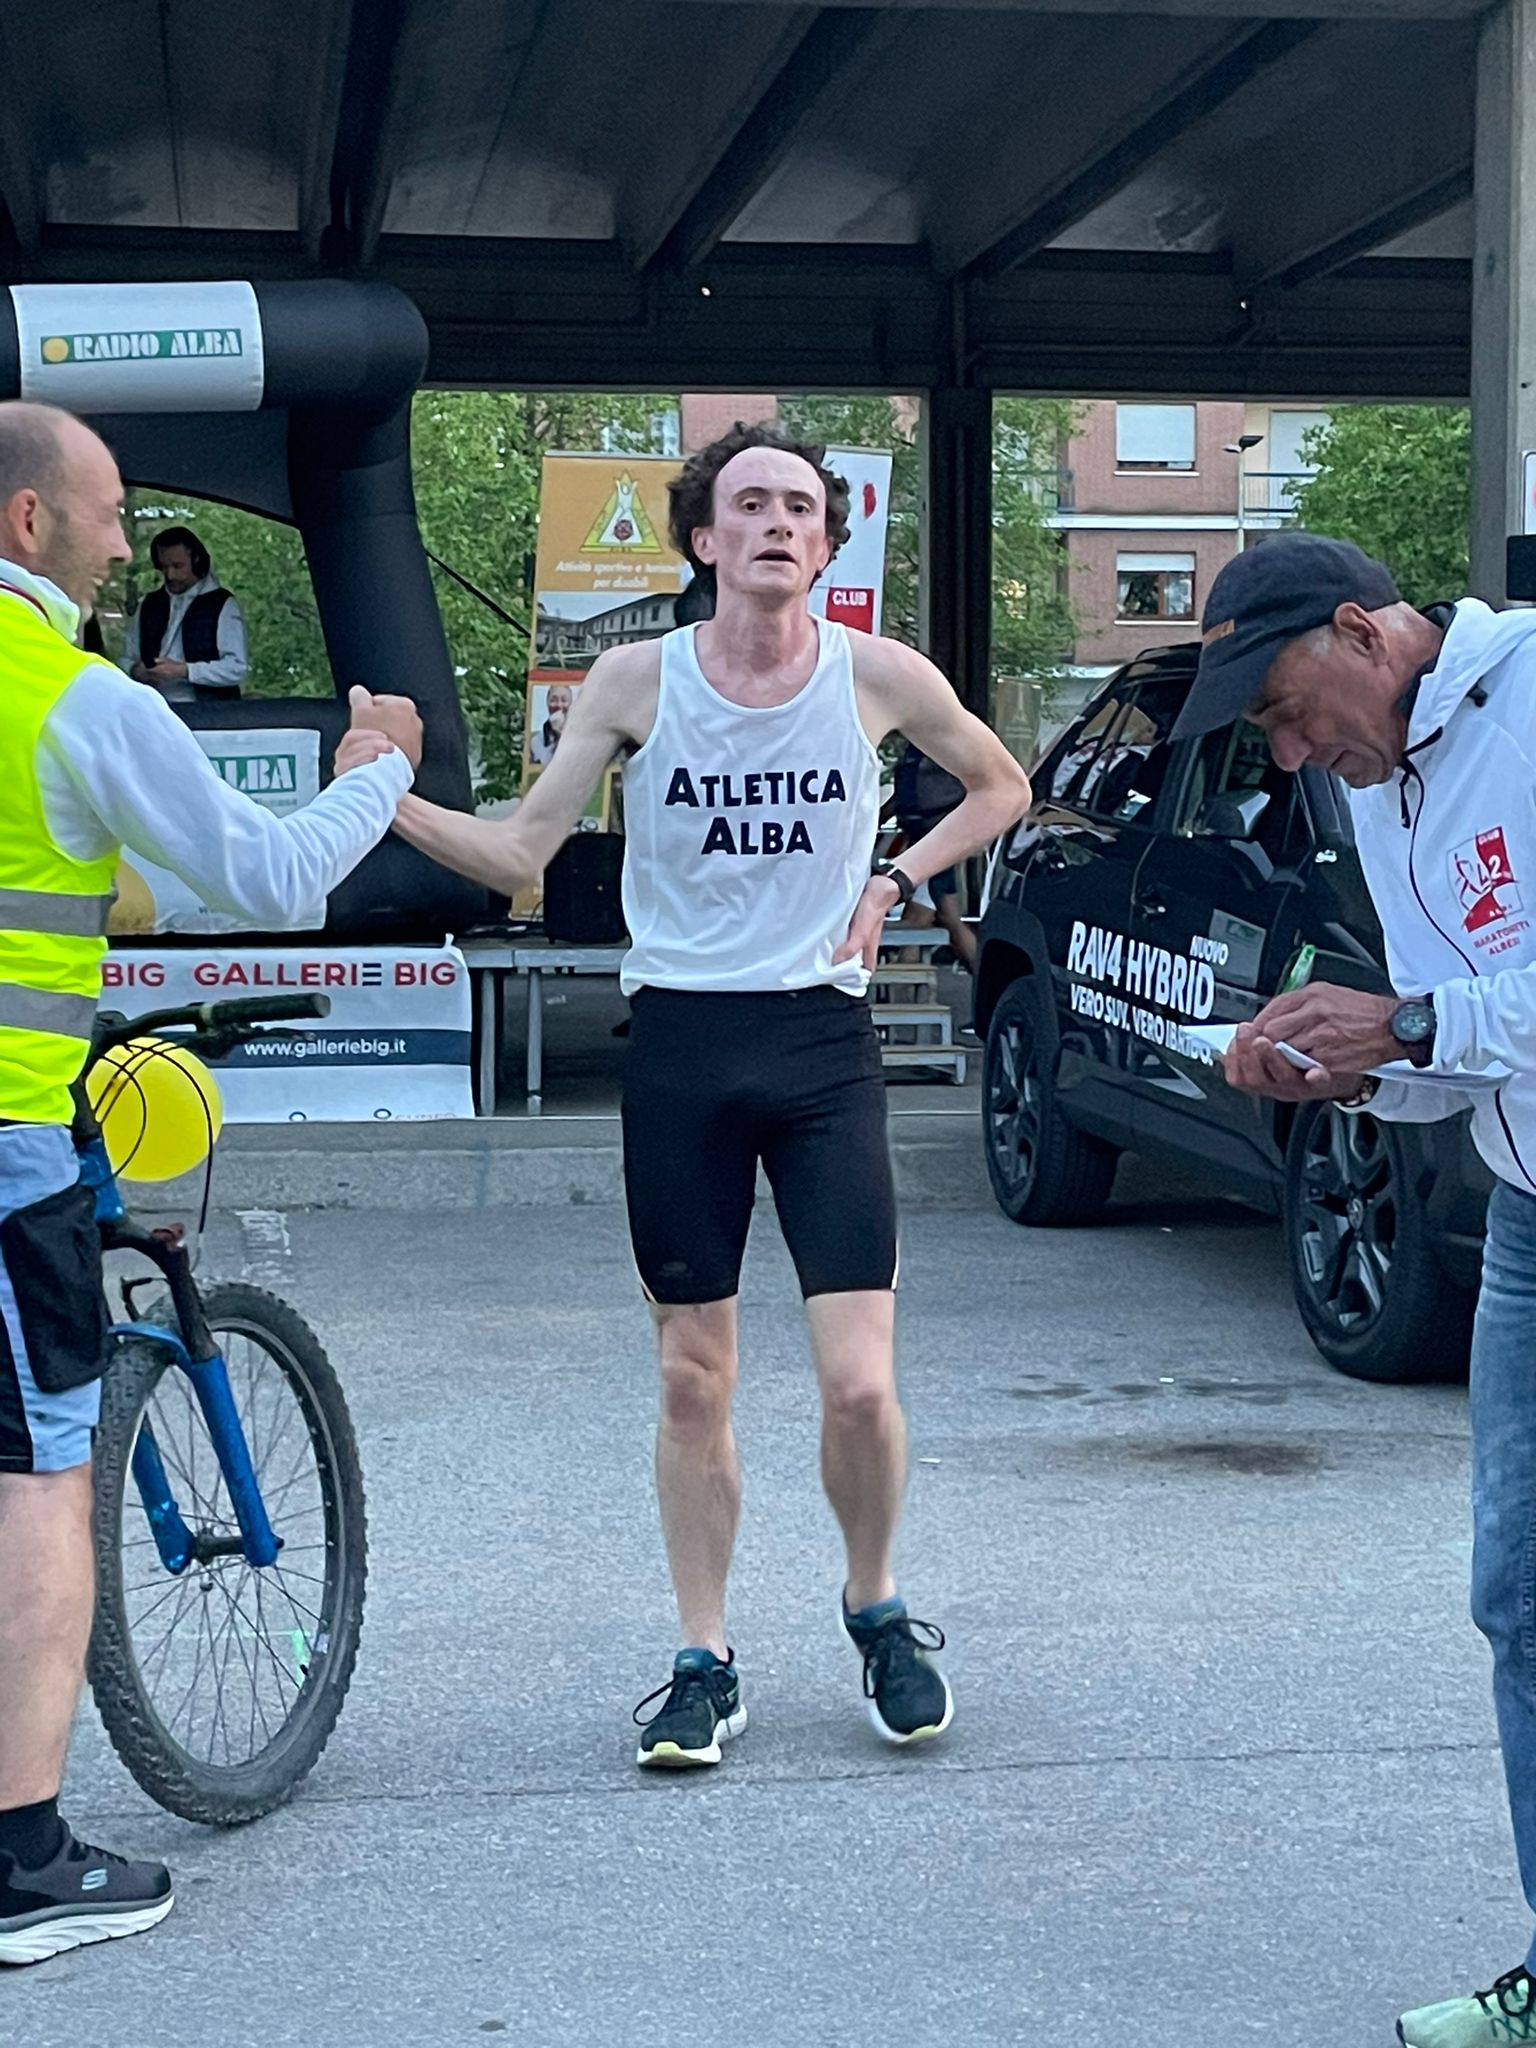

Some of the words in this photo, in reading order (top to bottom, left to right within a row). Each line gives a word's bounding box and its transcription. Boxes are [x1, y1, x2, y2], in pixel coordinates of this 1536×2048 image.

[73, 333, 160, 360] RADIO
[170, 330, 240, 356] ALBA
[832, 590, 868, 606] CLUB
[665, 767, 846, 808] ATLETICA
[701, 816, 814, 855] ALBA
[1189, 935, 1229, 966] NUOVO
[101, 962, 165, 987] BIG
[194, 962, 382, 987] GALLERIE
[395, 962, 456, 987] BIG
[1067, 920, 1124, 987] RAV4
[1126, 939, 1215, 1020] HYBRID
[1071, 983, 1105, 1020] VERO
[1132, 1006, 1165, 1045] VERO
[244, 1038, 407, 1058] www.galleriebig.it
